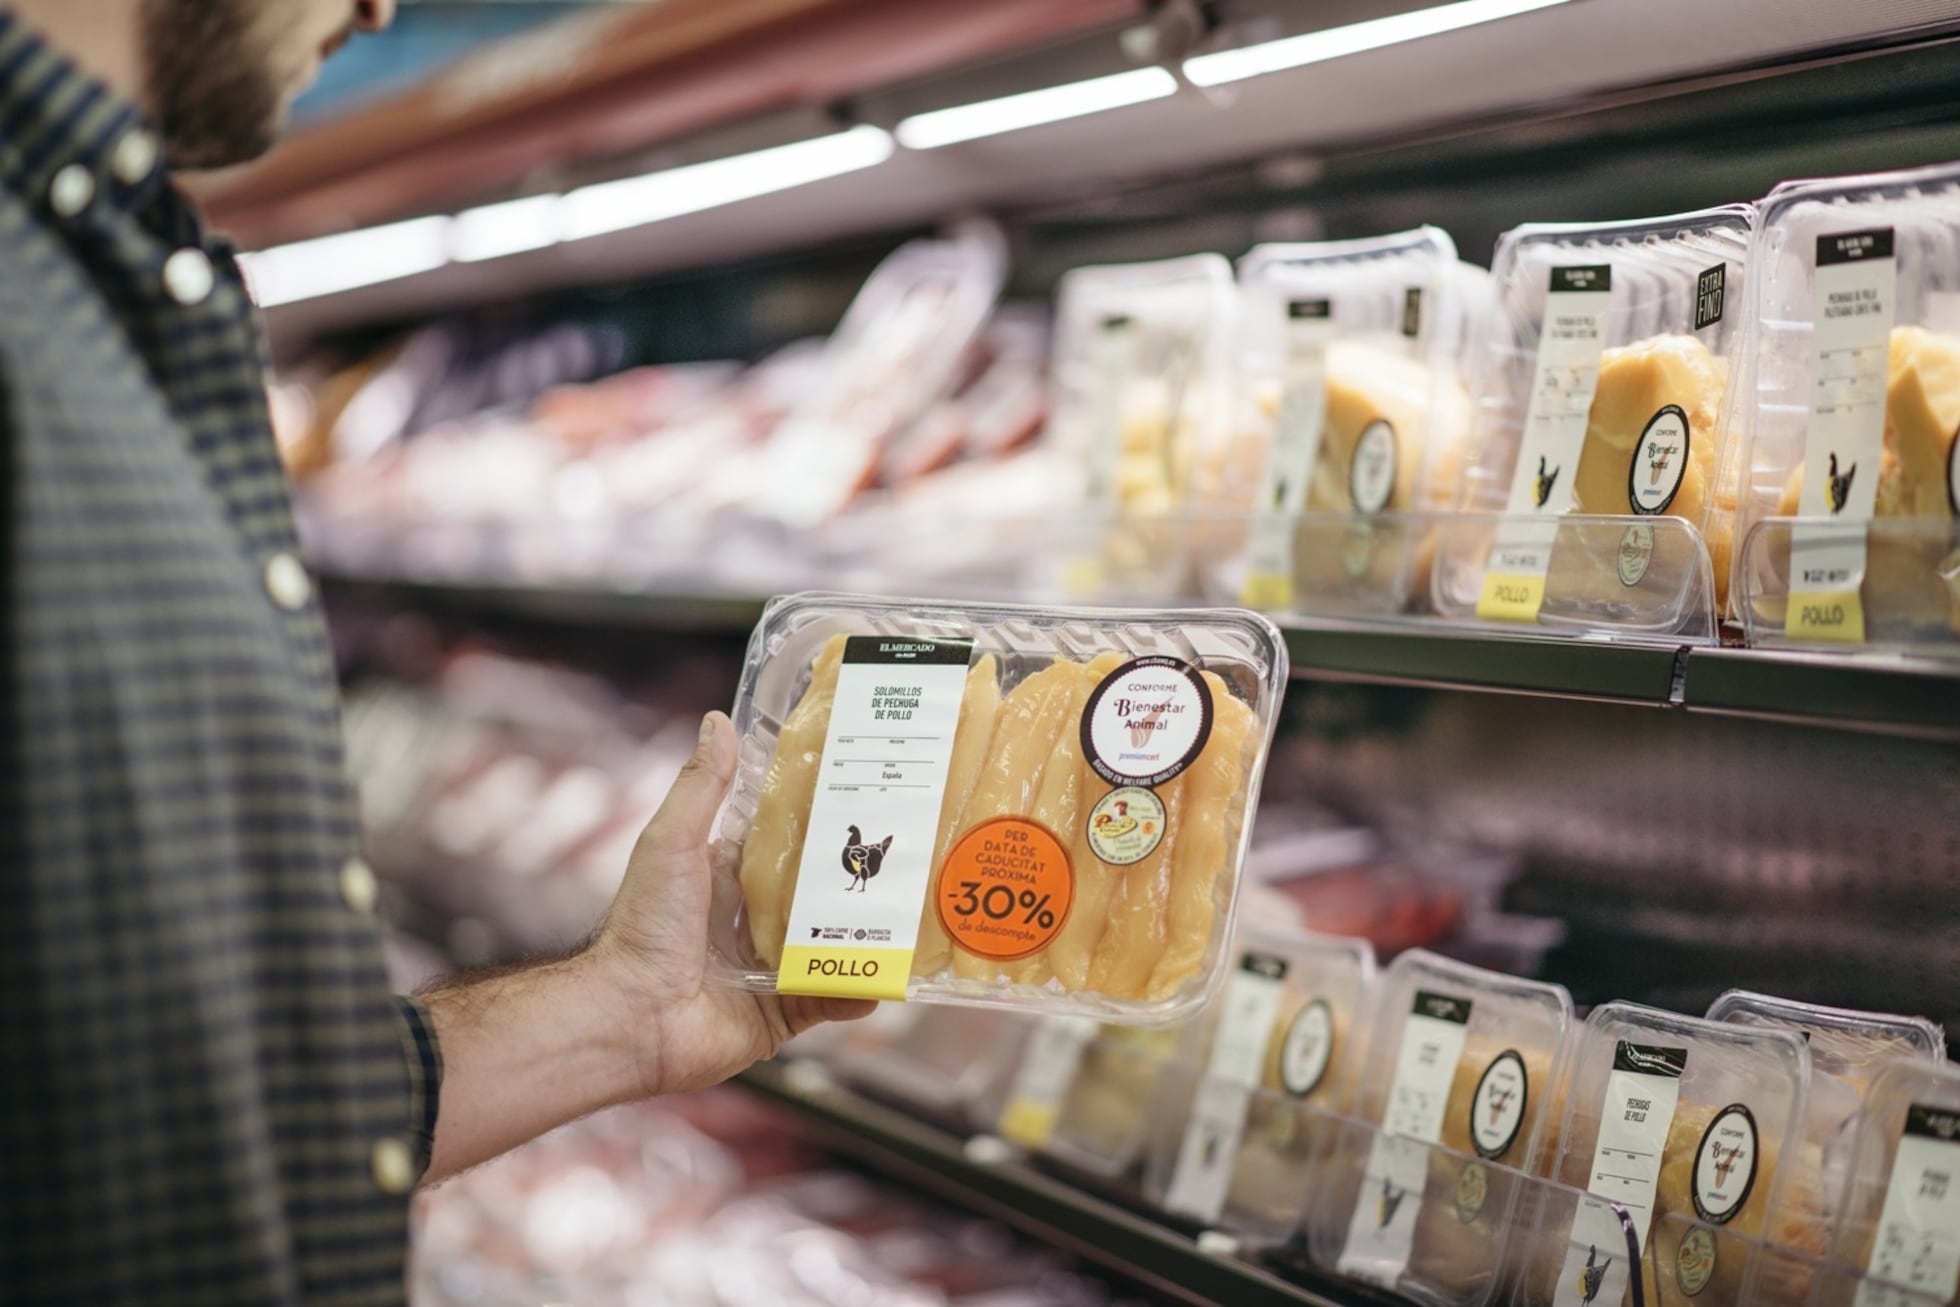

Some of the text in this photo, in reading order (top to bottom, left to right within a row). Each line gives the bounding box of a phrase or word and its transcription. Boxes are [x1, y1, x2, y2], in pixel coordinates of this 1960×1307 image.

[1700, 270, 1722, 295] EXTRA
[1698, 289, 1722, 324] FINO
[1801, 605, 1845, 626] POLLO
[874, 686, 922, 697] SOLOMILLOS
[1128, 683, 1178, 692] CONFORME
[872, 698, 920, 708] DE PECHUGA
[1113, 698, 1186, 717] Bienestar
[874, 710, 912, 720] DE POLLO
[1124, 718, 1168, 730] Animal
[1004, 829, 1028, 842] PER
[984, 840, 1037, 858] DATA DE
[975, 852, 1046, 873] CADUCITAT
[947, 881, 1055, 929] -30%
[958, 918, 1036, 942] de descompte
[807, 959, 879, 977] POLLO
[1626, 1097, 1651, 1111] PECHUGAS
[1624, 1110, 1647, 1122] DE POLLO
